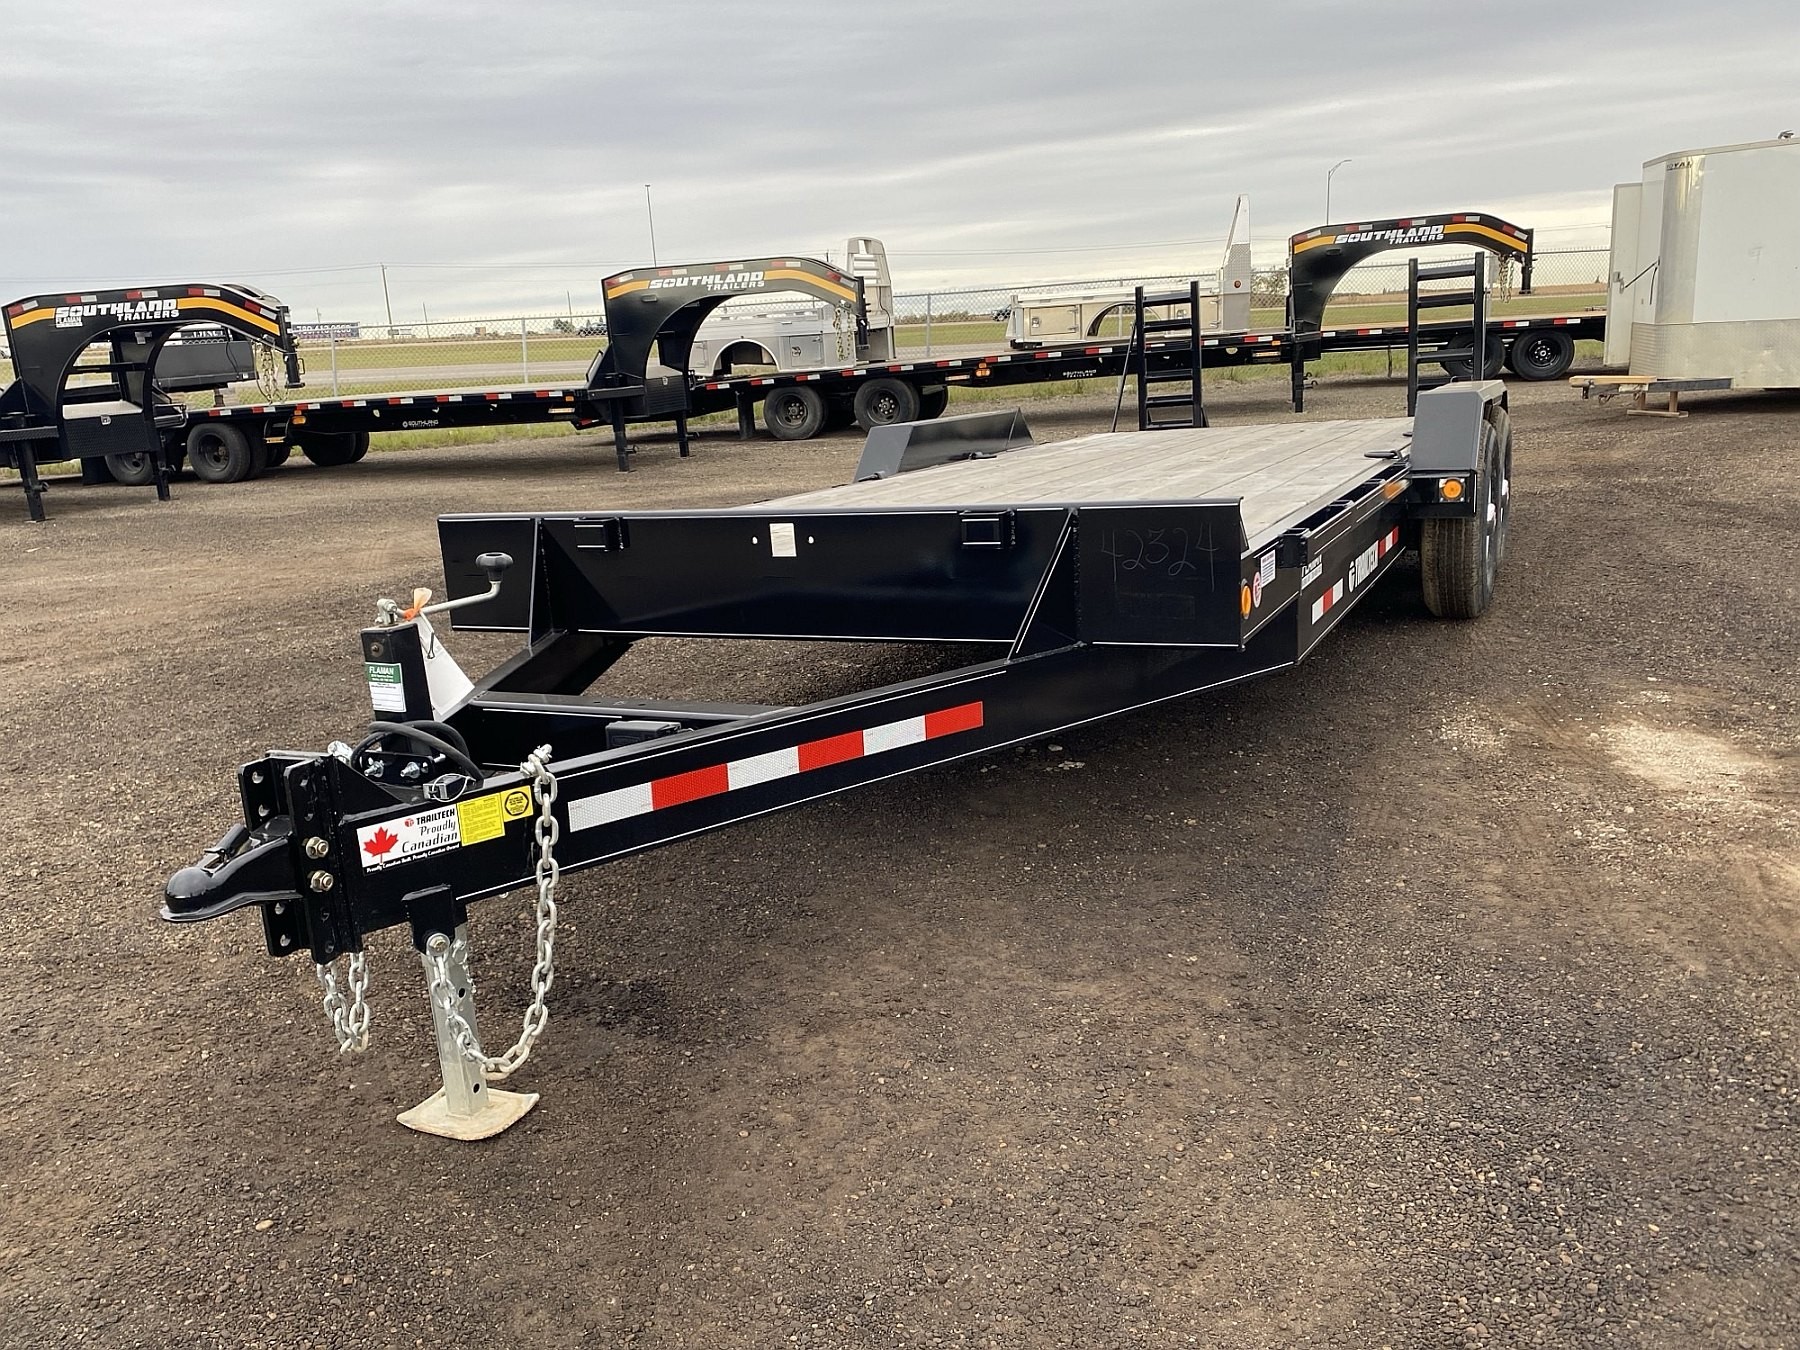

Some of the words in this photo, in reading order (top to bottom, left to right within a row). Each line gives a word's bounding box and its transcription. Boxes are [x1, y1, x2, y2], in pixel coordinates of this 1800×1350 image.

[1335, 225, 1444, 244] SOUTHLAND
[1390, 233, 1444, 245] TRAILERS
[649, 271, 764, 289] SOUTHLAND
[707, 280, 765, 291] TRAILERS
[56, 299, 177, 317] SOUTHLAND
[117, 309, 180, 321] TRAILERS
[1101, 522, 1220, 592] 42324
[369, 666, 394, 675] FLAMAN
[416, 808, 455, 825] TRAILTECH
[418, 819, 456, 836] Proudly
[402, 832, 457, 853] Canadian
